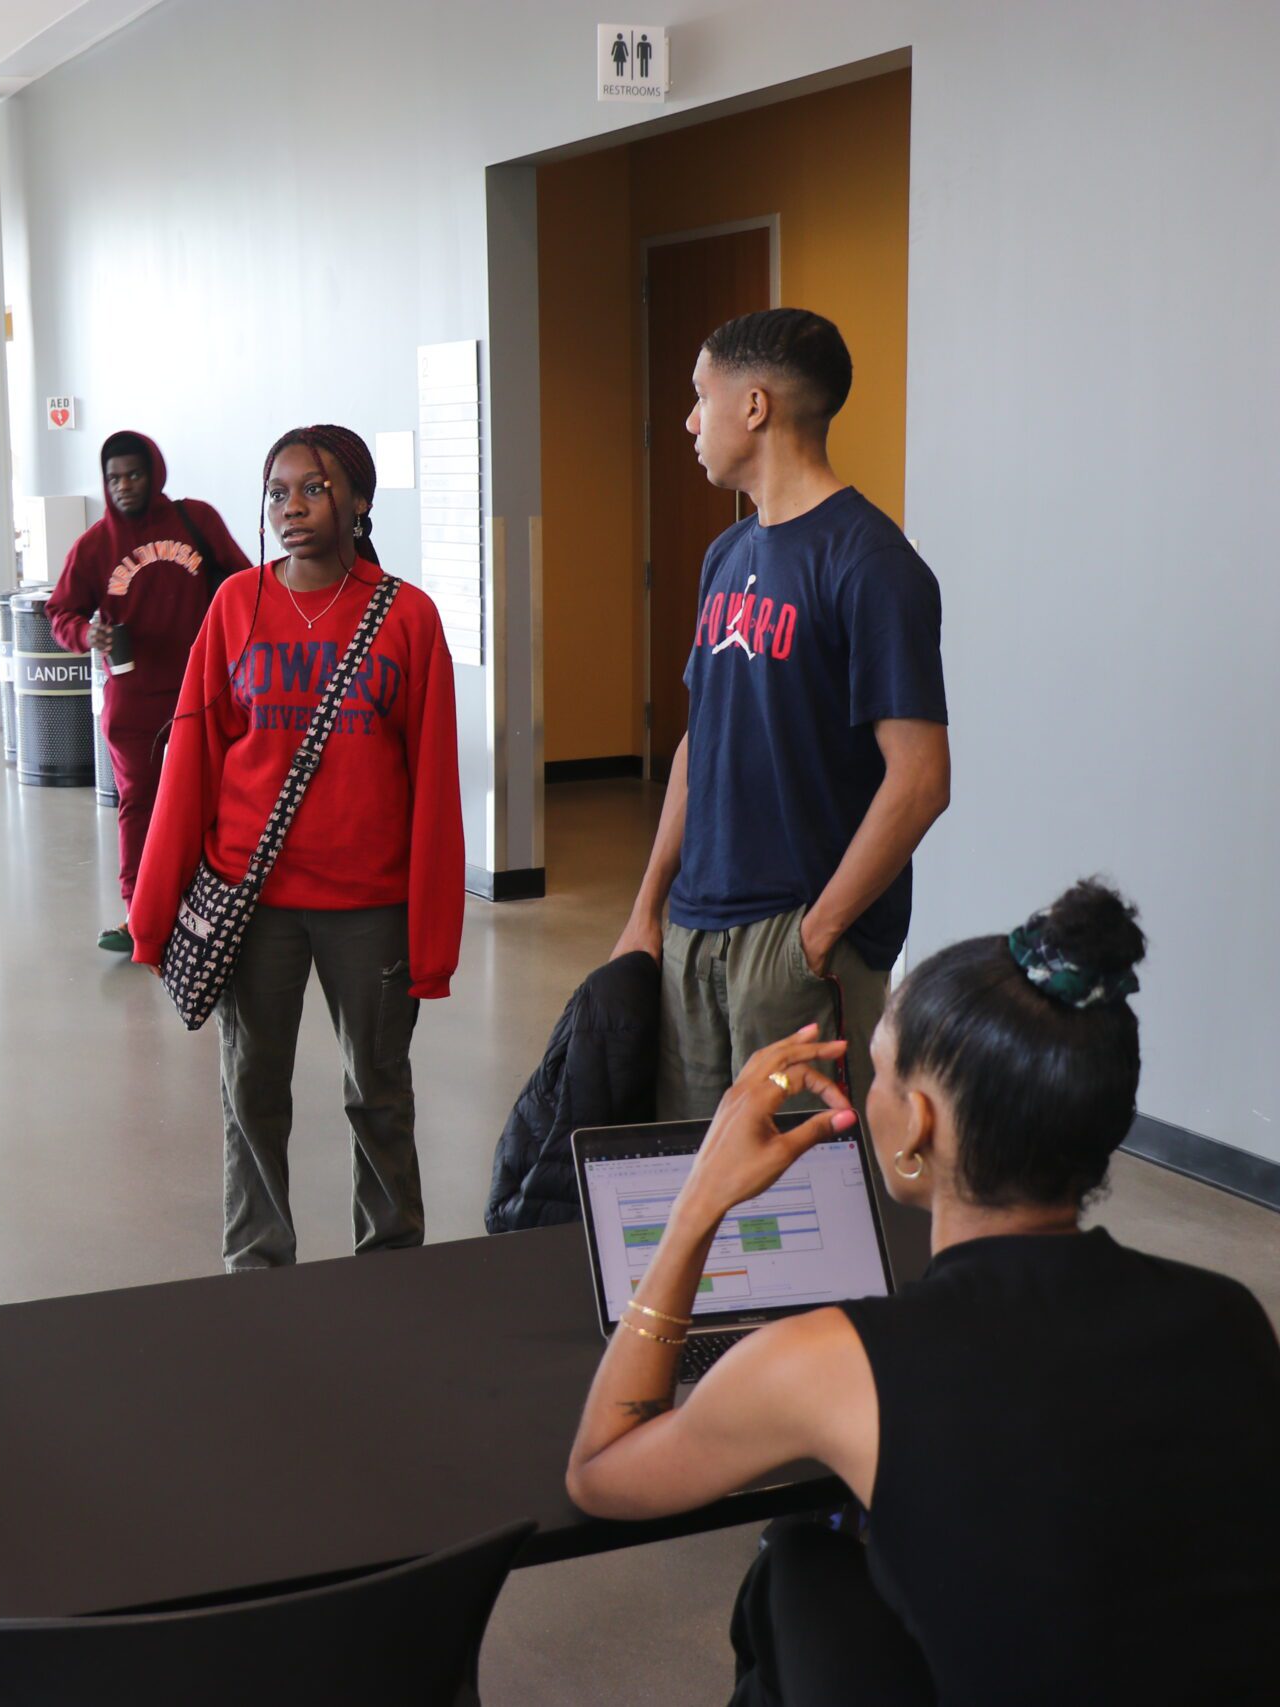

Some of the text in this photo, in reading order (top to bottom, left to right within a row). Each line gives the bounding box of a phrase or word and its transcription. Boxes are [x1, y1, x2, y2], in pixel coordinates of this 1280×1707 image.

[603, 84, 661, 97] RESTROOMS
[50, 398, 70, 409] AED
[26, 666, 92, 682] LANDFIL
